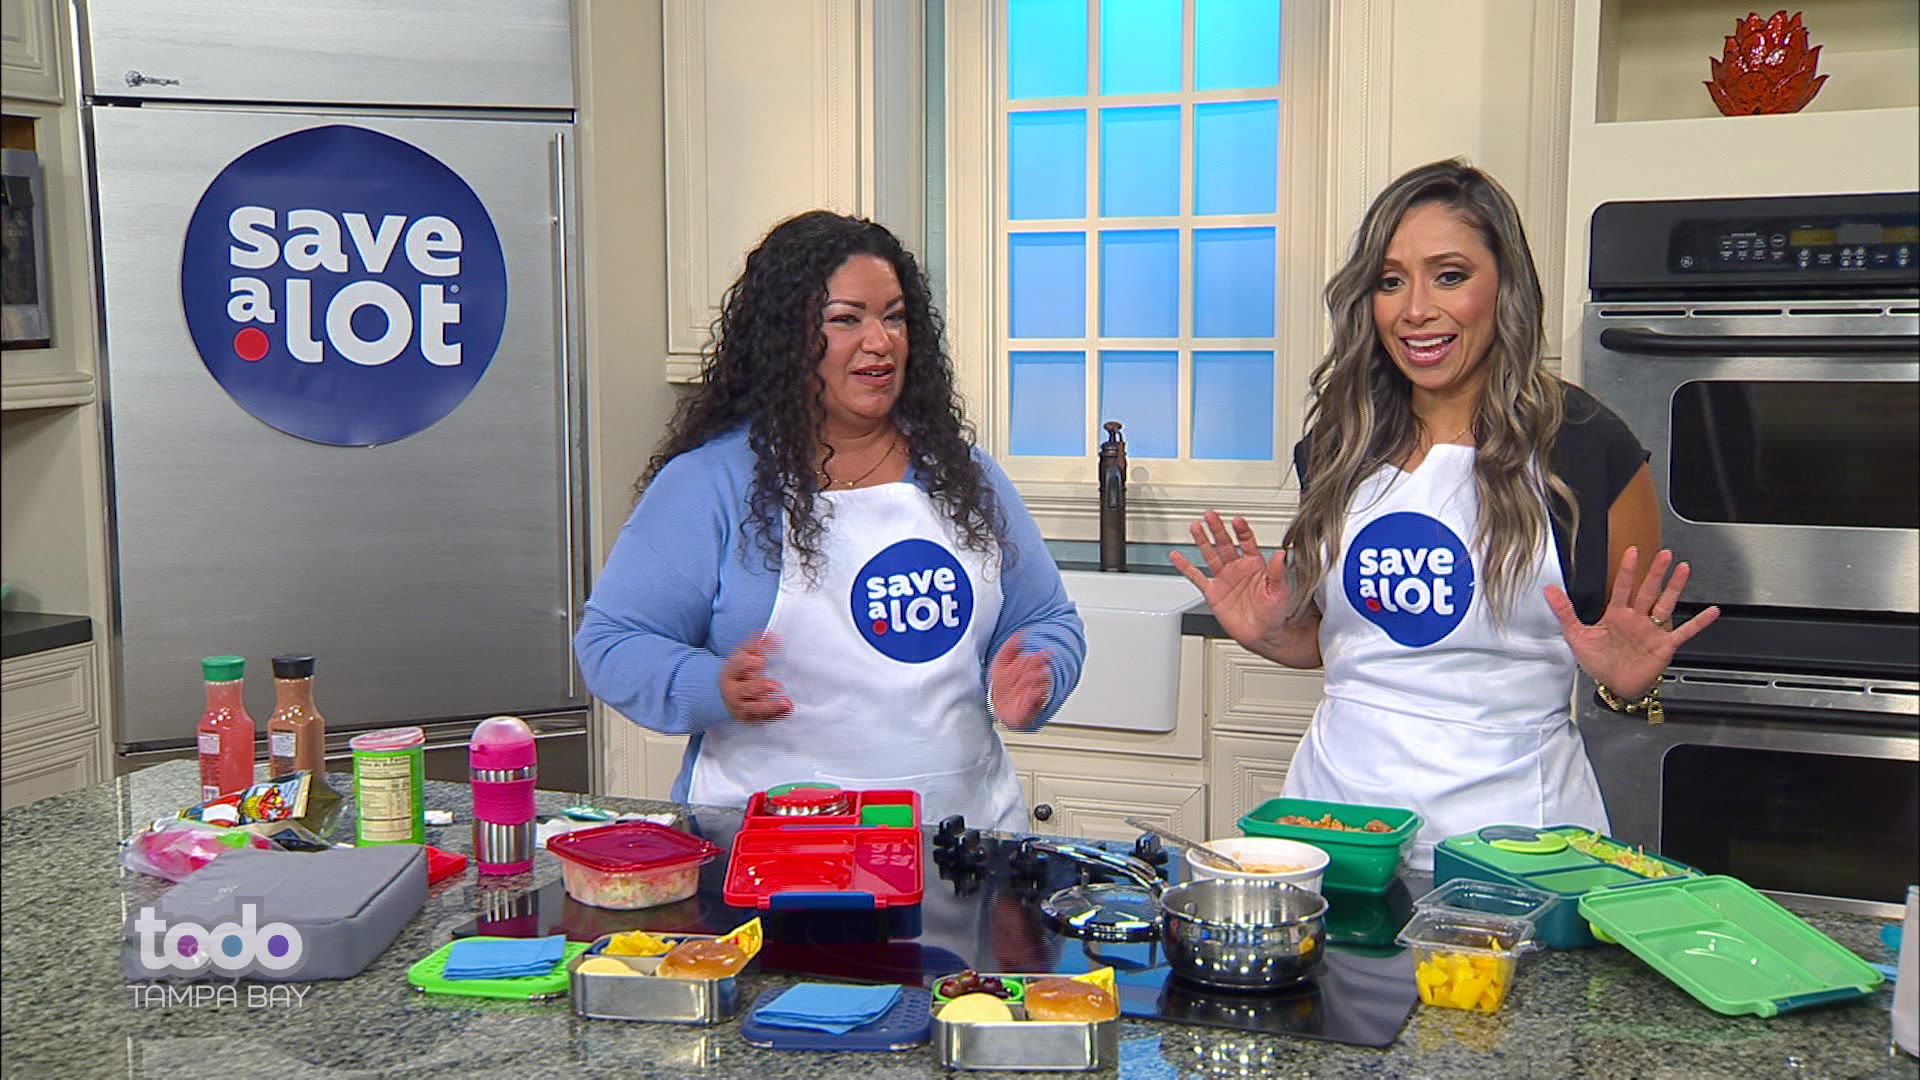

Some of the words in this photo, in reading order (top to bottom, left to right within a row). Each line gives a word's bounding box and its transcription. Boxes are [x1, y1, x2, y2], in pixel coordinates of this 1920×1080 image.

[228, 206, 463, 277] save
[1359, 547, 1455, 576] save
[866, 567, 957, 600] save
